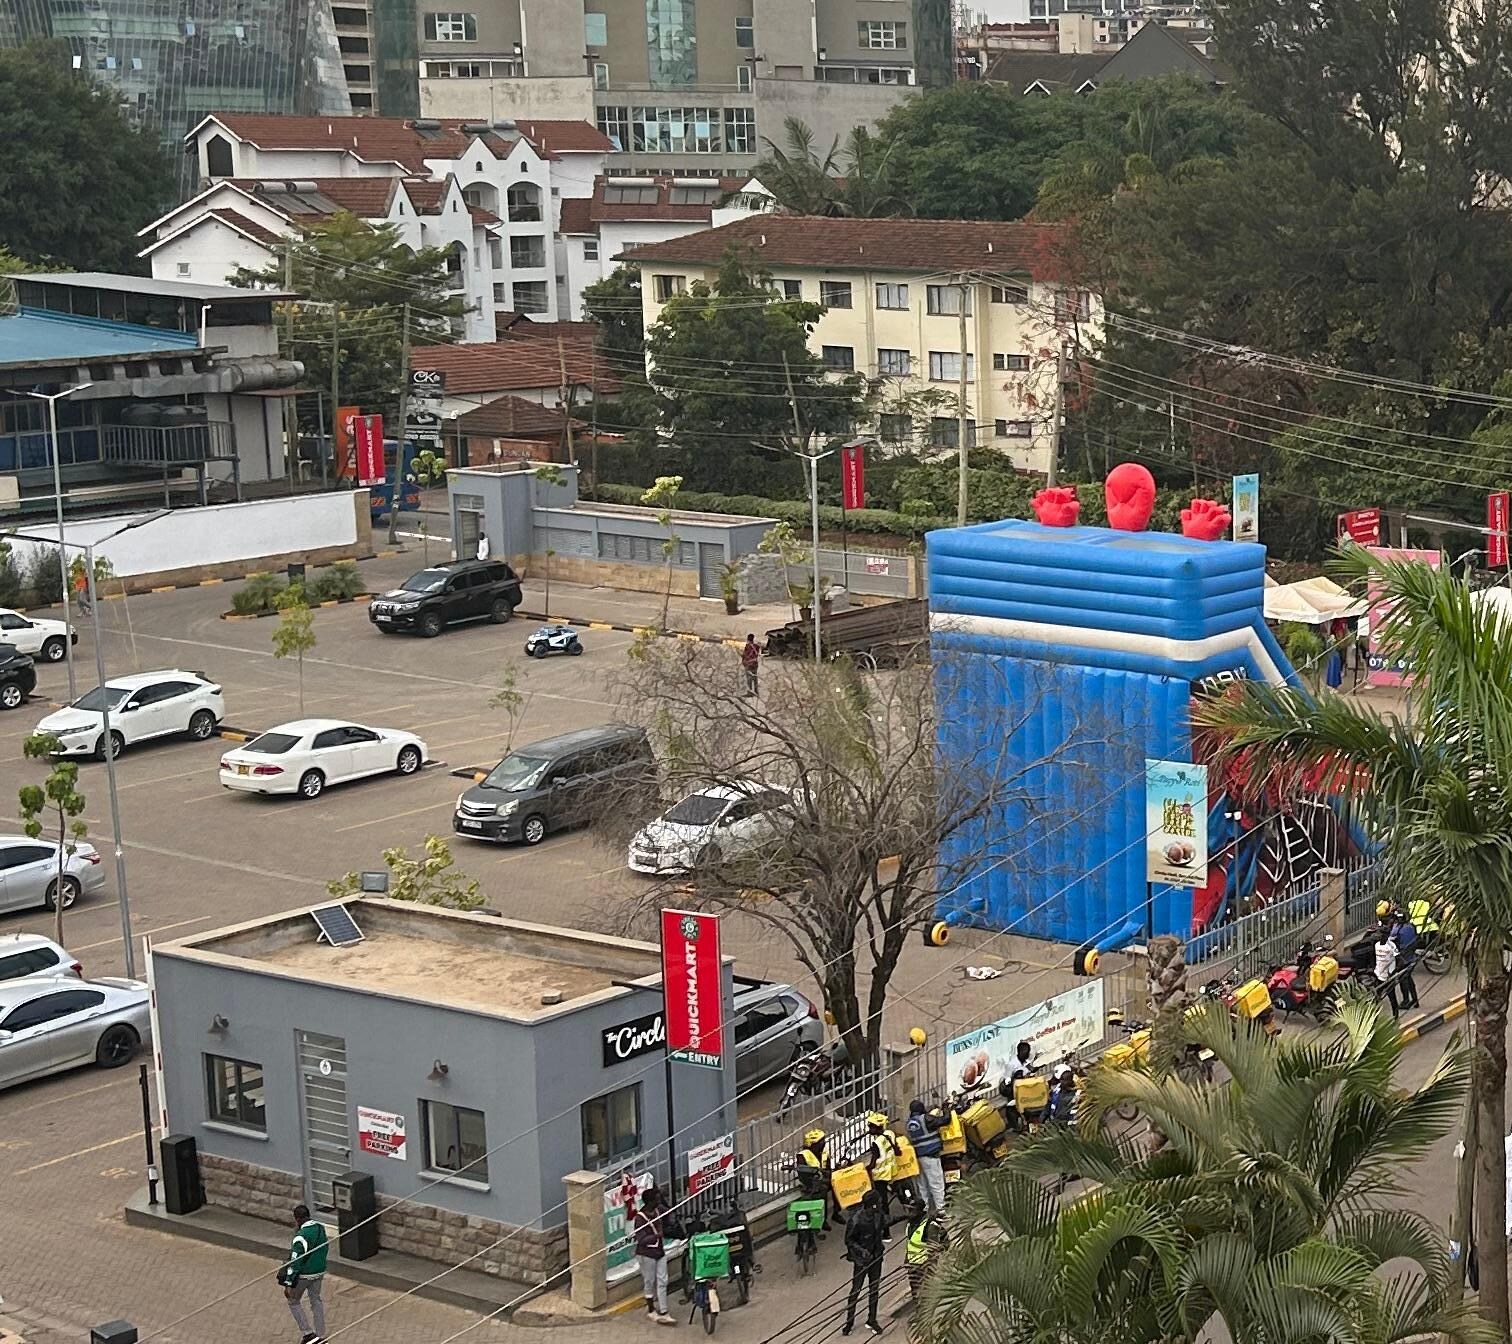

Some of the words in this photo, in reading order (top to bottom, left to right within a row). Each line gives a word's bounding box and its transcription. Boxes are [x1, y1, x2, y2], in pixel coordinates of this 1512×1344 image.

[685, 941, 700, 1049] QUICKMART
[688, 1053, 720, 1066] ENTRY
[372, 1131, 390, 1141] FREE
[367, 1140, 399, 1154] PARKING
